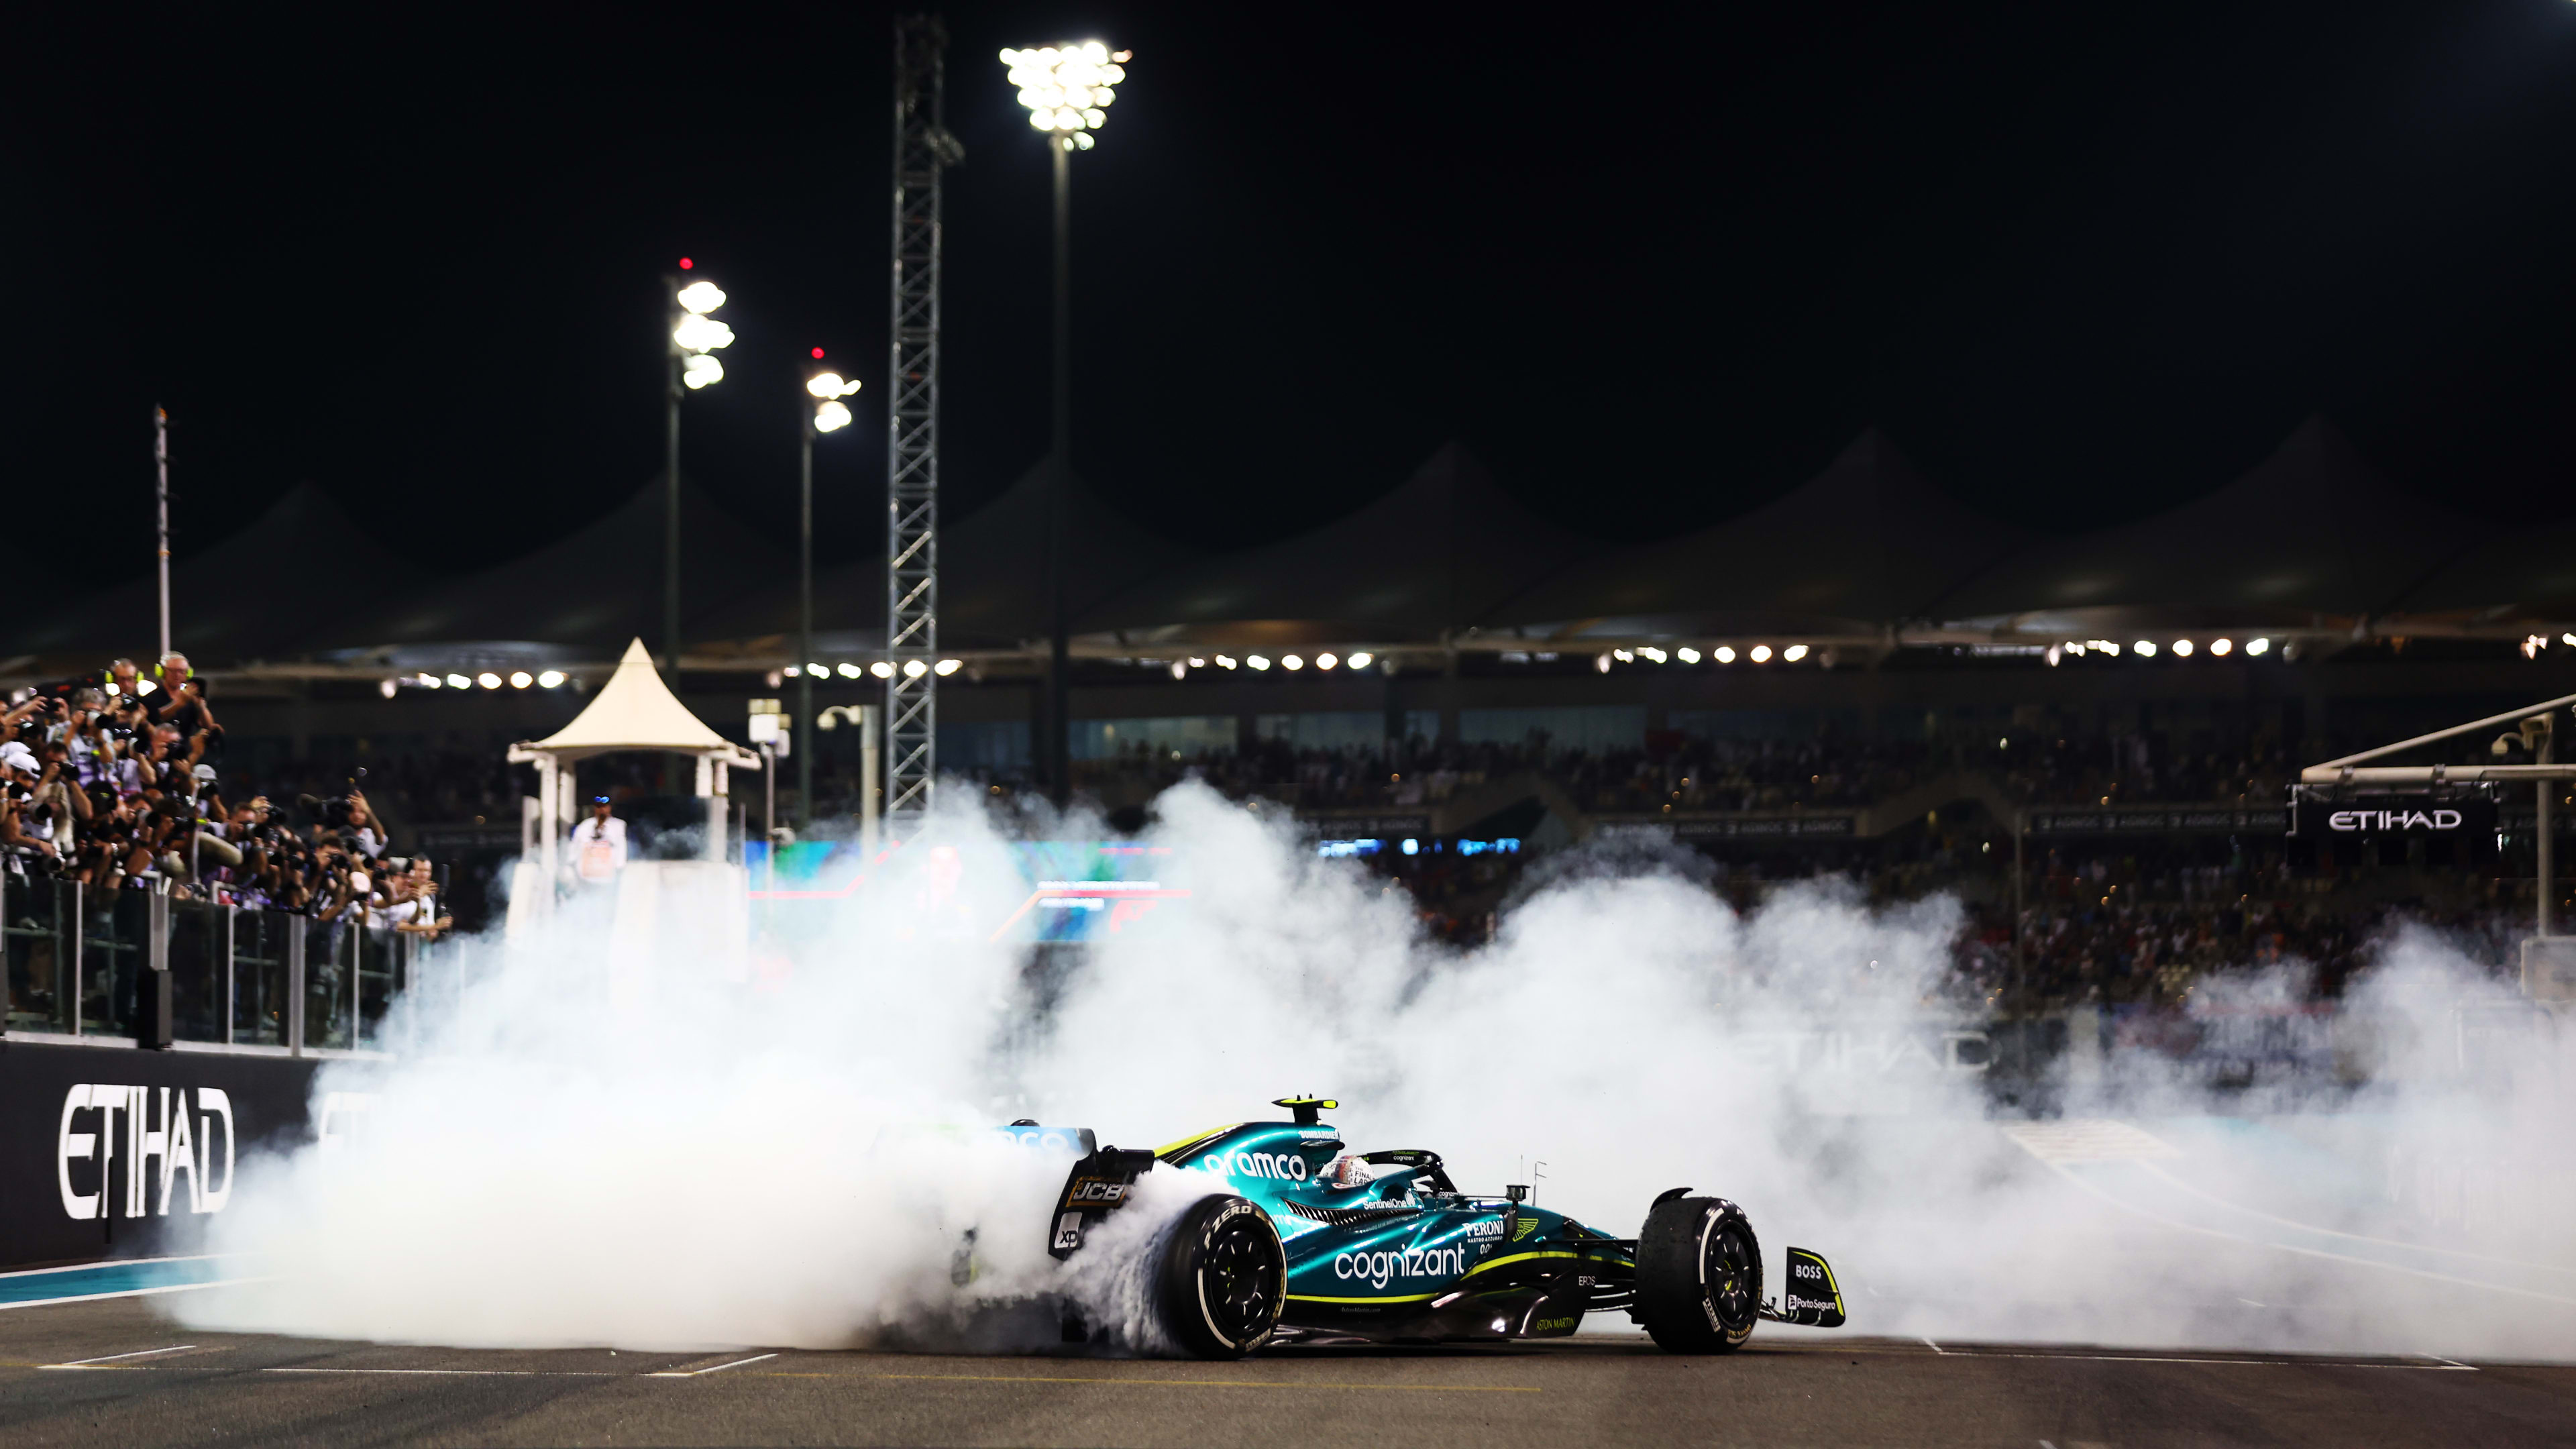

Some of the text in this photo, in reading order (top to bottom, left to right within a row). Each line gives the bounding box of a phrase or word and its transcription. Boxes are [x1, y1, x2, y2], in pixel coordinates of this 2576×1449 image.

[2329, 810, 2462, 830] ETIHAD
[1299, 1130, 1339, 1139] BOMBARDIER
[58, 1083, 235, 1220] ETIHAD
[1203, 1149, 1307, 1181] aramco
[1355, 1171, 1372, 1181] FINAL
[1073, 1182, 1124, 1200] JCB
[1363, 1197, 1407, 1210] SentinelOne
[1462, 1220, 1503, 1237] PERONI
[1335, 1242, 1465, 1289] cognizant
[1796, 1265, 1821, 1279] BOSS
[1578, 1275, 1596, 1286] EPOS
[1536, 1316, 1574, 1331] ASTON MARTIN
